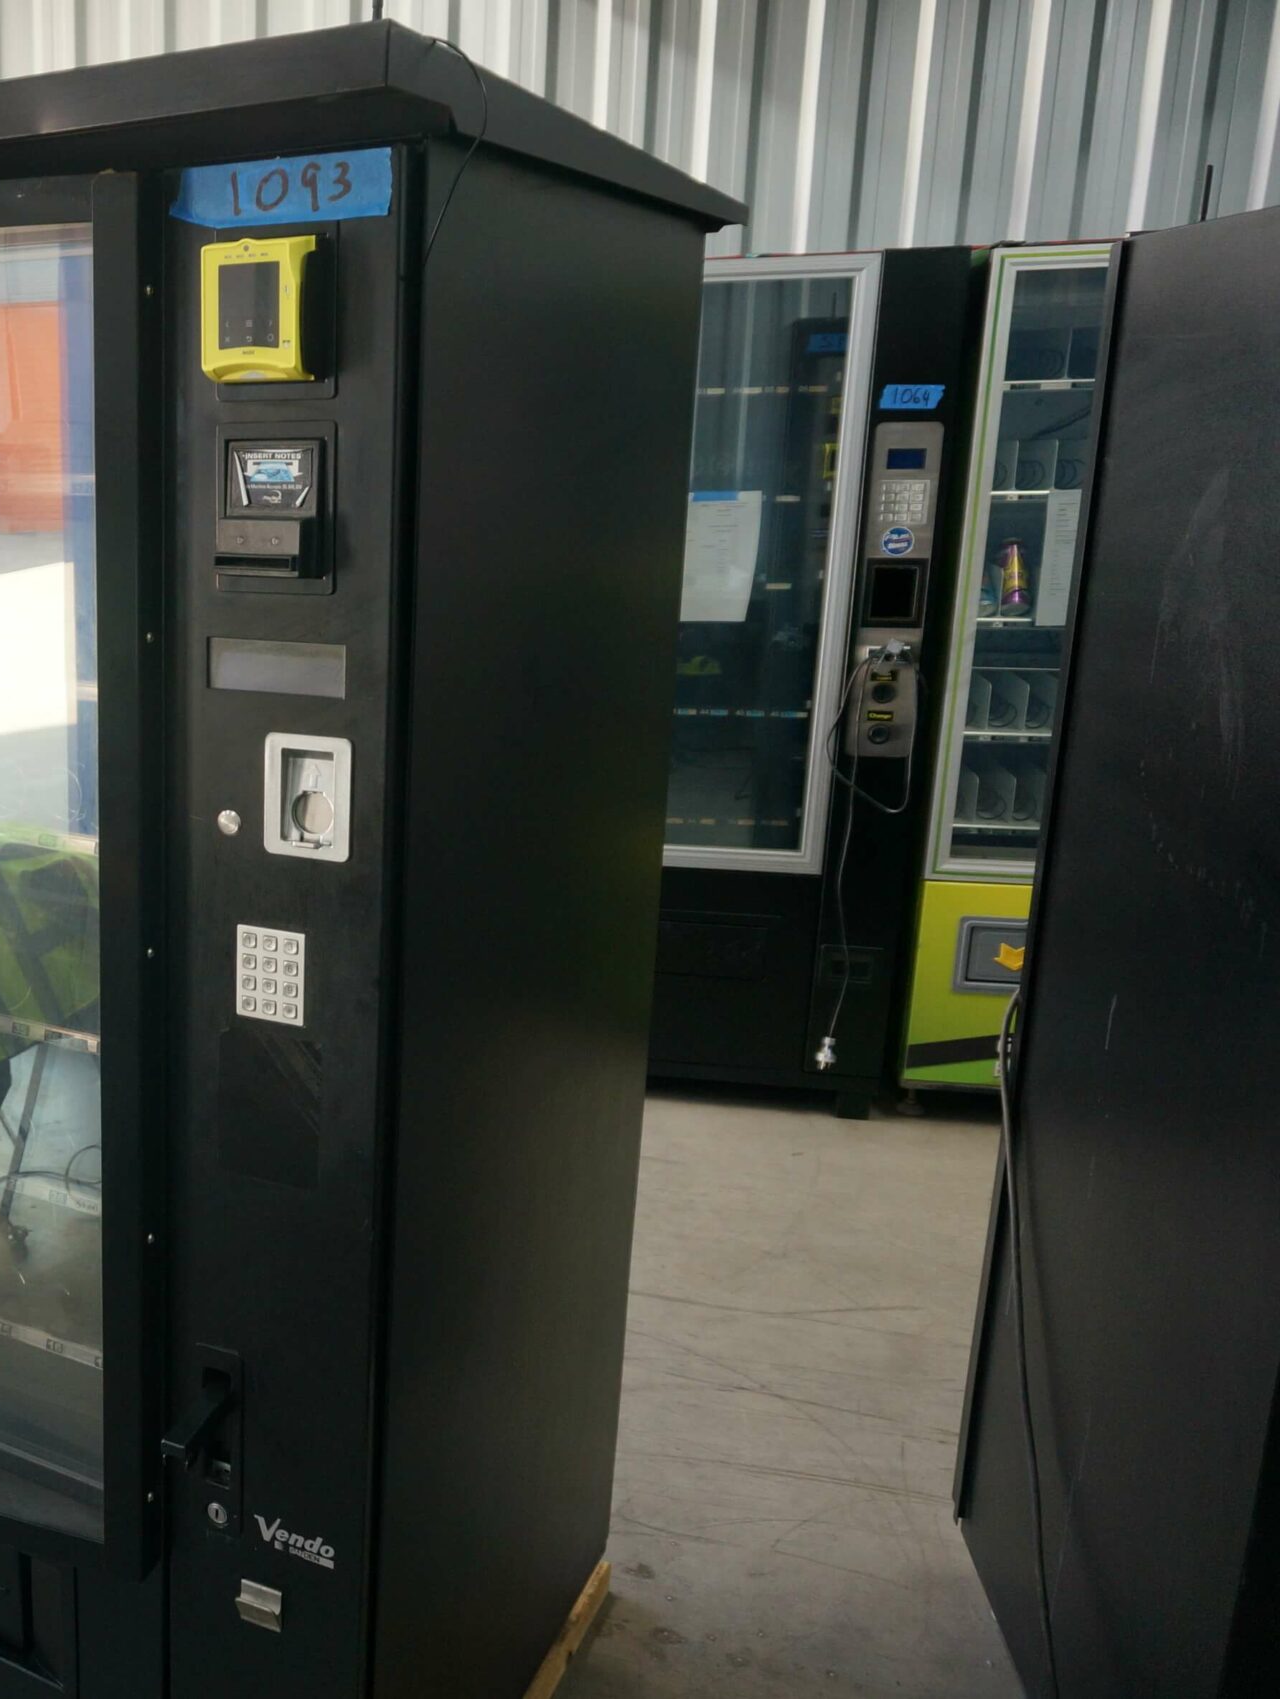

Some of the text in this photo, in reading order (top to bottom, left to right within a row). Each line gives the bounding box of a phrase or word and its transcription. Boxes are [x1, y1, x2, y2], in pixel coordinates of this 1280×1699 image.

[232, 161, 353, 217] 1093
[892, 386, 930, 407] 1064
[245, 452, 301, 460] INSERT NOTES
[253, 1513, 335, 1558] Vendo
